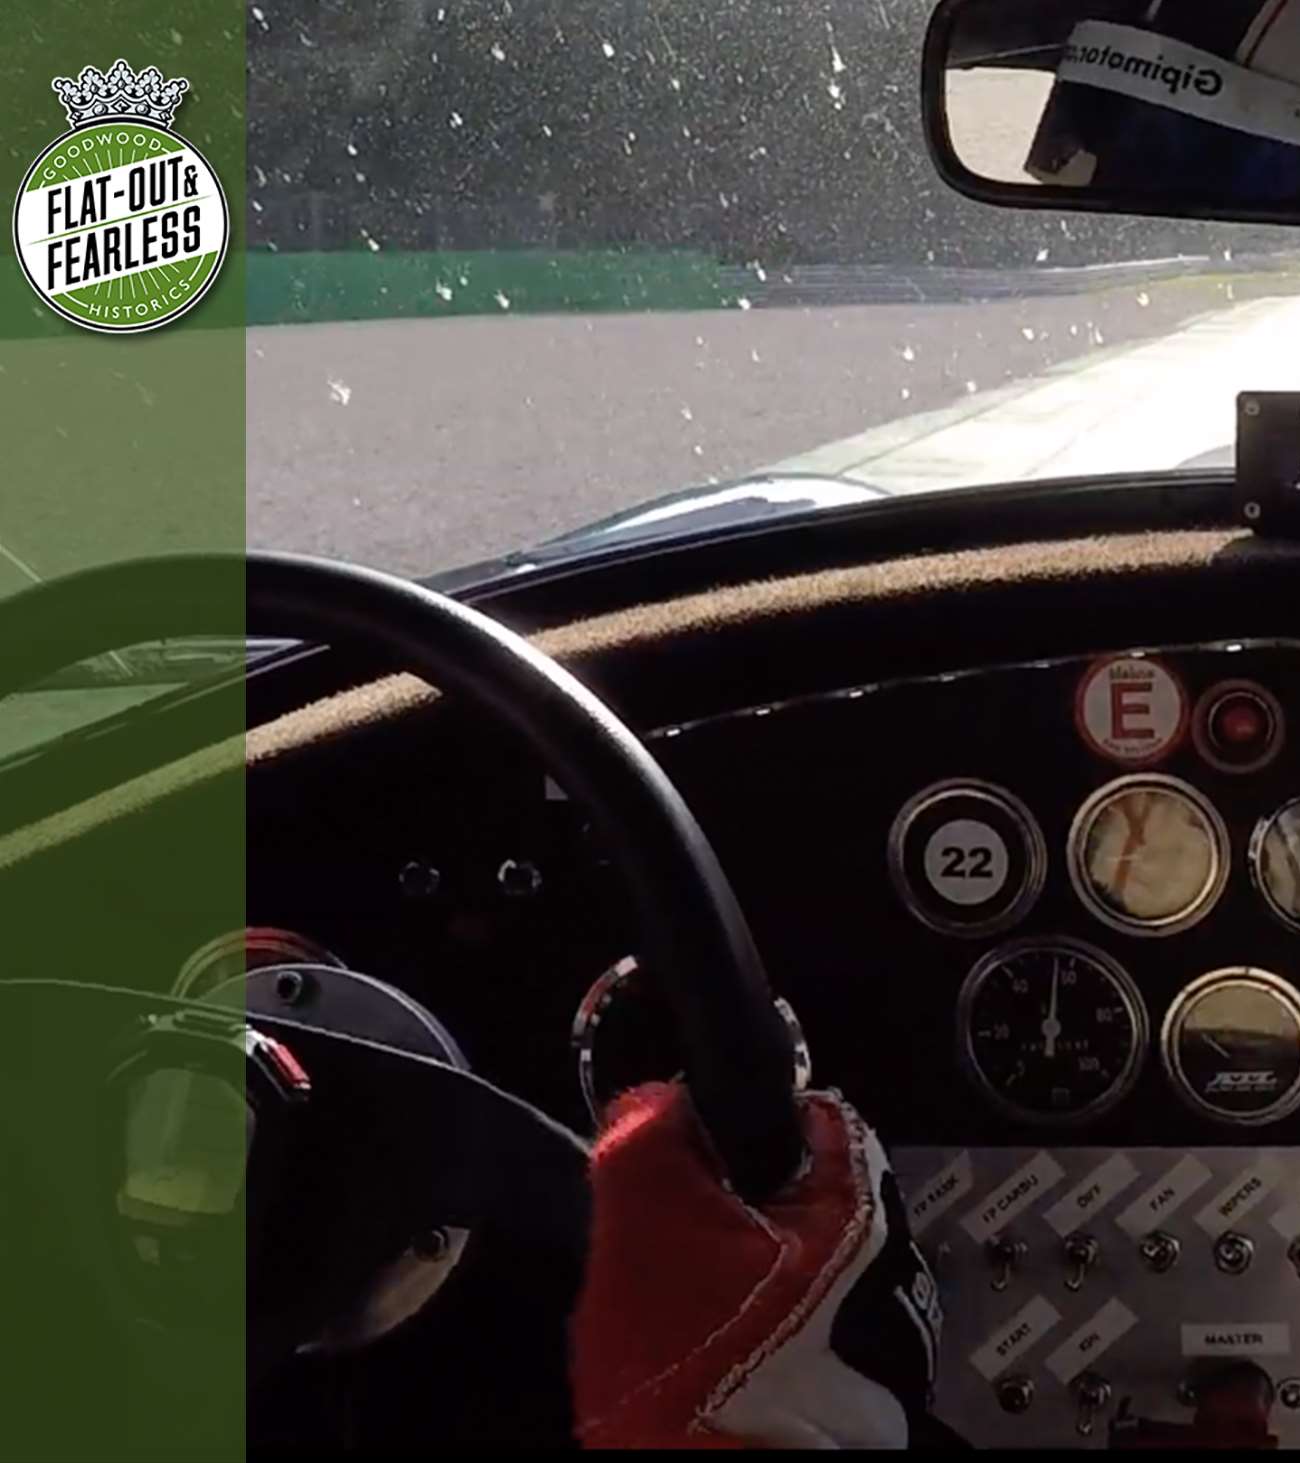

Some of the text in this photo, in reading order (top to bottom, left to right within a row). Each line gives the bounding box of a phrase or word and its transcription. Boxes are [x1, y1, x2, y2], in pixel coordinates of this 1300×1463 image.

[1111, 682, 1156, 740] E
[940, 846, 994, 879] 22
[1150, 1187, 1175, 1211] FAN
[995, 1323, 1031, 1356] START
[1203, 1332, 1264, 1346] MASTER
